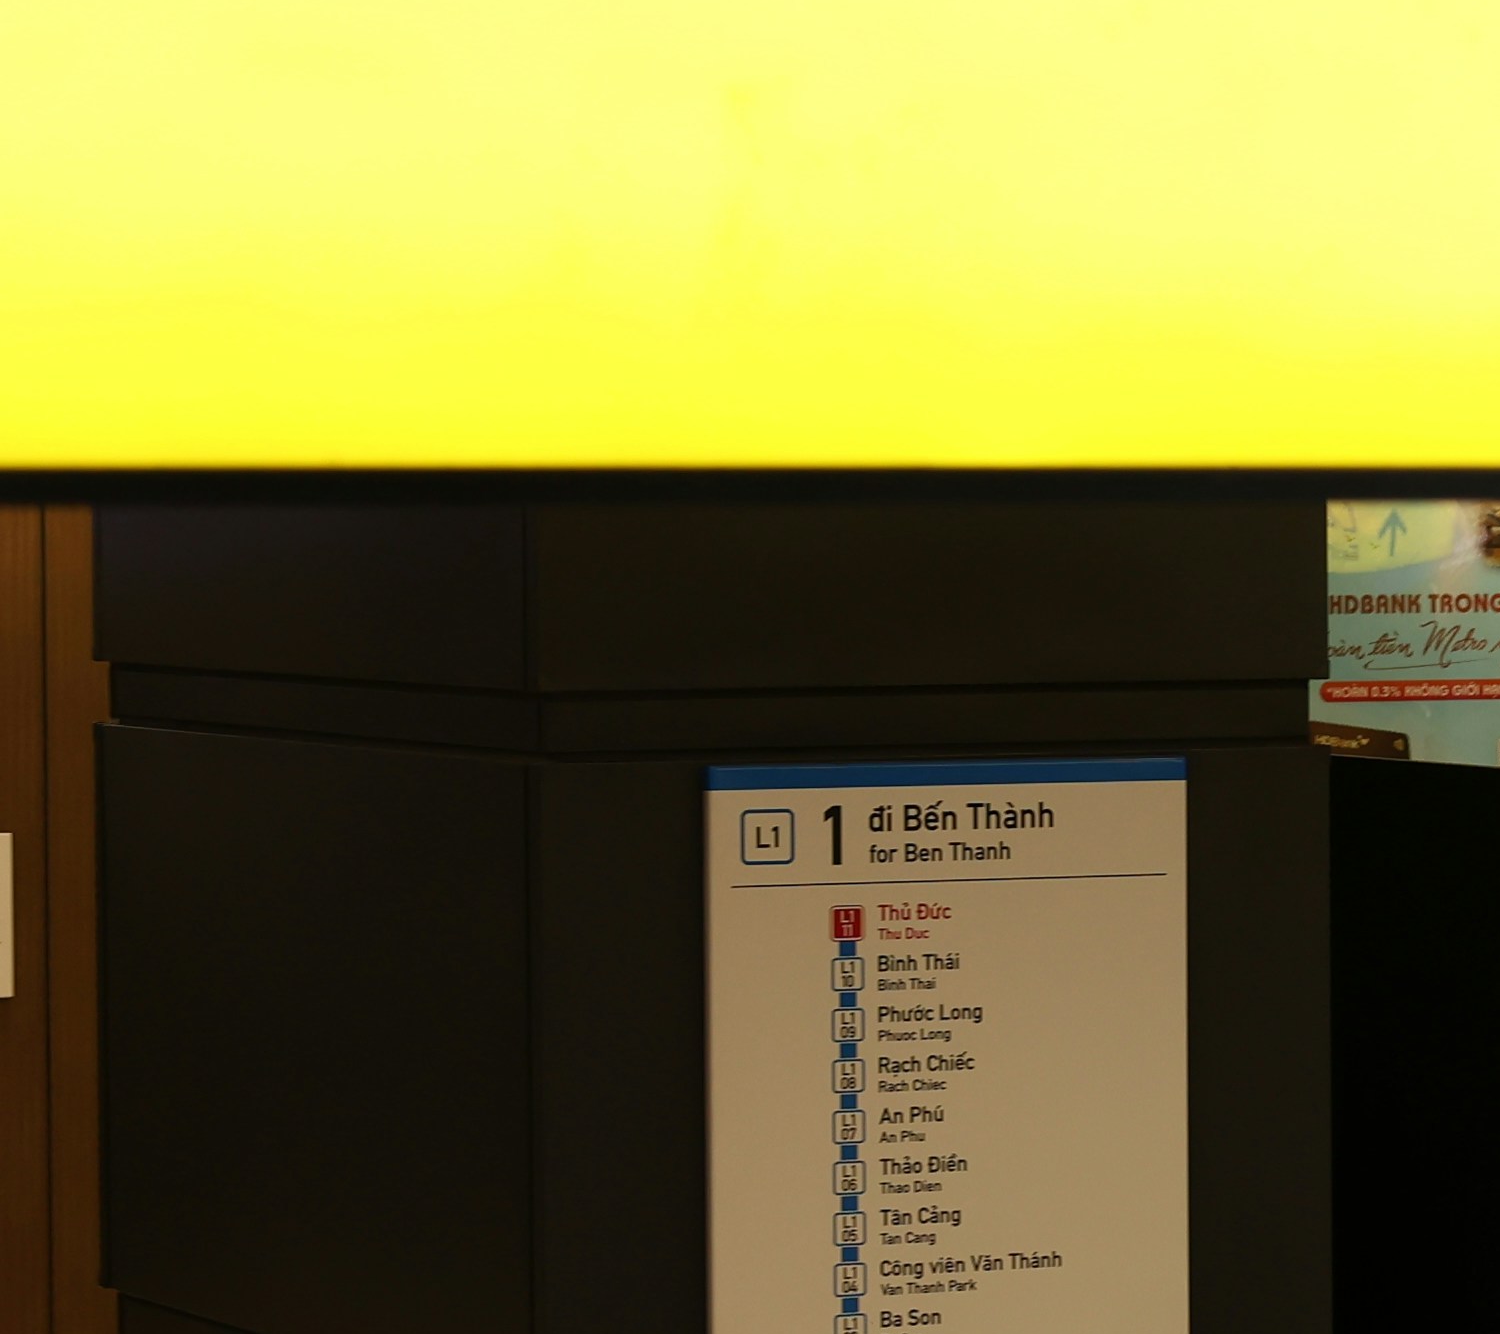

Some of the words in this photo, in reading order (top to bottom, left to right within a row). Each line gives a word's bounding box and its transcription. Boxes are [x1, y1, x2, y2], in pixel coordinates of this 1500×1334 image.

[1329, 594, 1421, 615] HDBANK
[869, 805, 892, 832] đi
[904, 801, 957, 831] Bến
[967, 801, 1054, 830] Thành
[756, 826, 779, 849] L1
[823, 805, 842, 865] 1
[870, 844, 897, 863] for
[905, 843, 942, 862] Ben
[950, 841, 1010, 861] Thanh
[878, 902, 911, 921] Thủ
[916, 902, 952, 920] Đức
[878, 928, 901, 940] Thu
[905, 927, 929, 939] Duc
[878, 955, 917, 972] Bình
[923, 953, 960, 971] Thái
[878, 979, 906, 991] Binh
[909, 978, 936, 990] Thai
[878, 1006, 934, 1023] Phước
[939, 1004, 983, 1023] Long
[878, 1030, 917, 1042] Phuoc
[920, 1029, 952, 1042] Long
[878, 1056, 921, 1077] Rạch
[927, 1051, 976, 1071] Chiếc
[878, 1081, 909, 1092] Rach
[913, 1079, 947, 1091] Chiec
[879, 1108, 903, 1124] An
[909, 1106, 944, 1123] Phú
[879, 1132, 897, 1143] An
[901, 1130, 925, 1143] Phu
[880, 1157, 922, 1176] Thảo
[928, 1154, 967, 1173] Điền
[880, 1182, 910, 1194] Thao
[914, 1181, 942, 1193] Dien
[880, 1209, 912, 1226] Tân
[918, 1205, 961, 1226] Cảng
[880, 1233, 902, 1245] Tan
[905, 1232, 936, 1246] Cang
[880, 1259, 923, 1279] Công
[931, 1258, 965, 1273] viên
[971, 1255, 1003, 1272] Văn
[1009, 1251, 1062, 1269] Thánh
[881, 1284, 903, 1296] Van
[907, 1281, 945, 1294] Thanh
[949, 1280, 977, 1292] Park
[880, 1312, 902, 1328] Ba
[908, 1310, 941, 1326] Son
